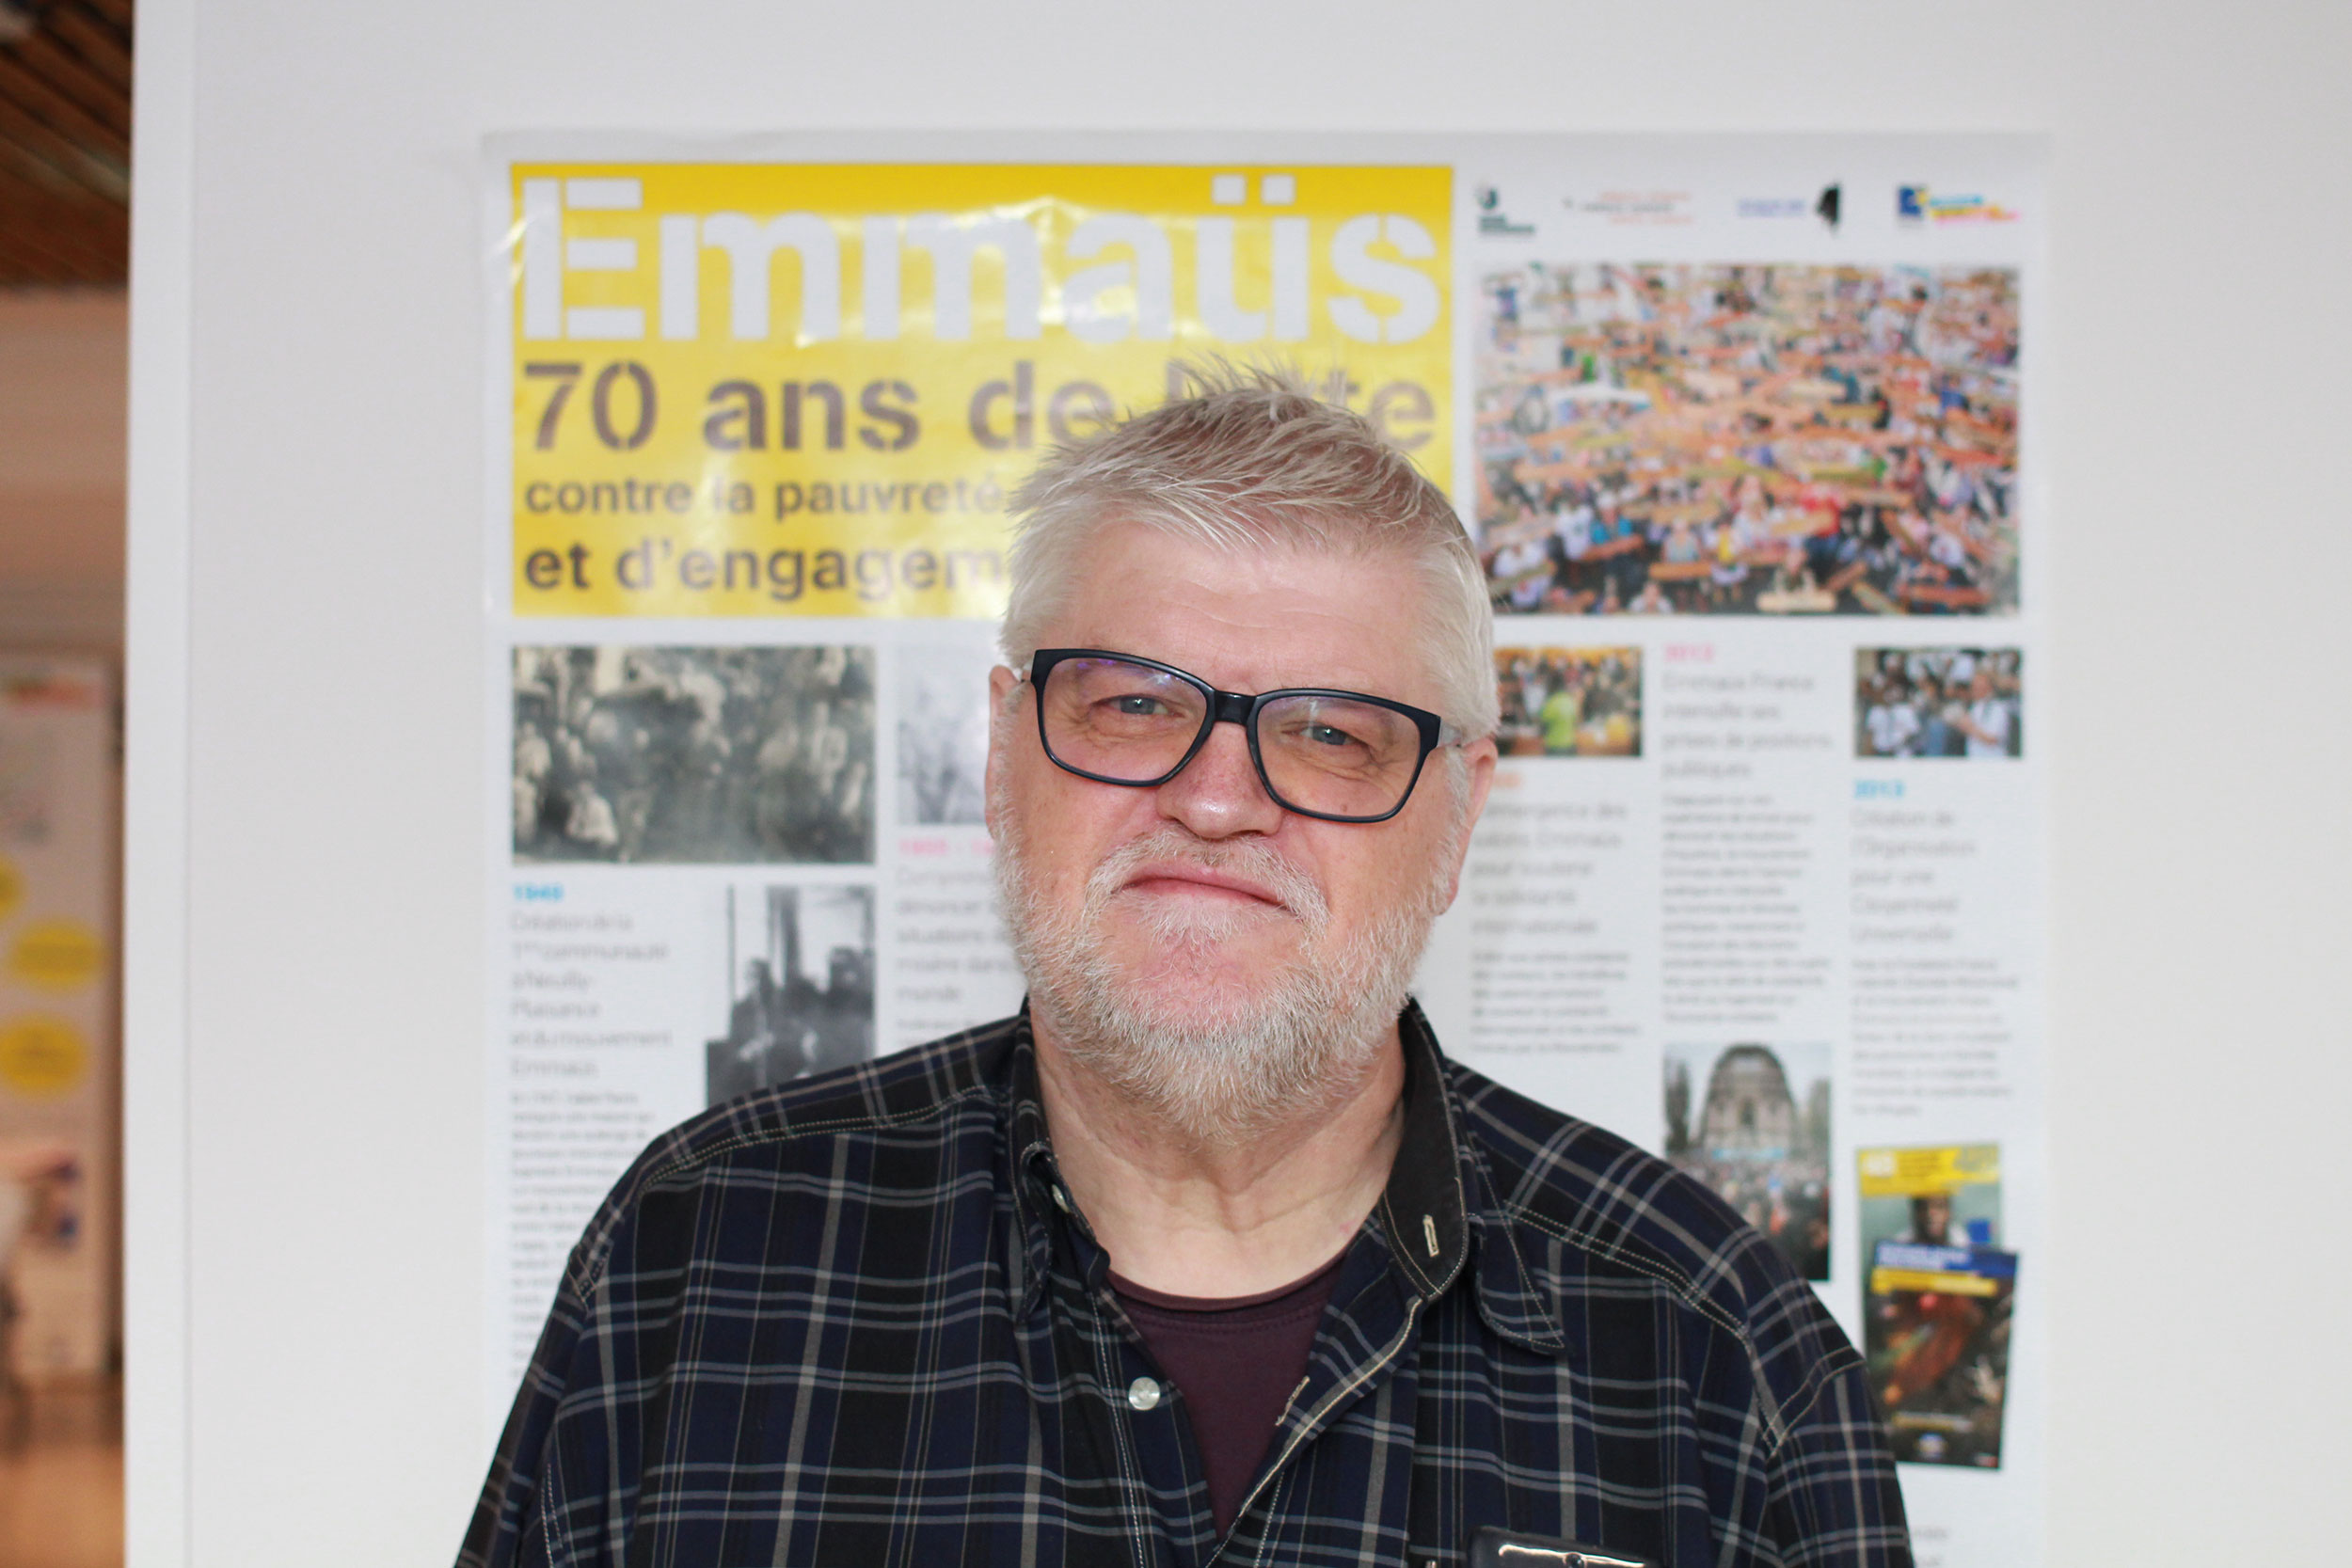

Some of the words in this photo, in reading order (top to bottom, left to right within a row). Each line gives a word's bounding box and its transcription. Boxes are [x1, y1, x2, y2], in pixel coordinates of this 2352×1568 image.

[522, 175, 1441, 344] Emmaüs
[523, 359, 657, 452] 70
[703, 379, 921, 452] ans
[968, 359, 1115, 451] de
[524, 477, 692, 515] contre
[710, 475, 755, 515] la
[776, 471, 1002, 522] pauvreté
[524, 543, 591, 590] et
[615, 538, 1003, 603] d'engagem
